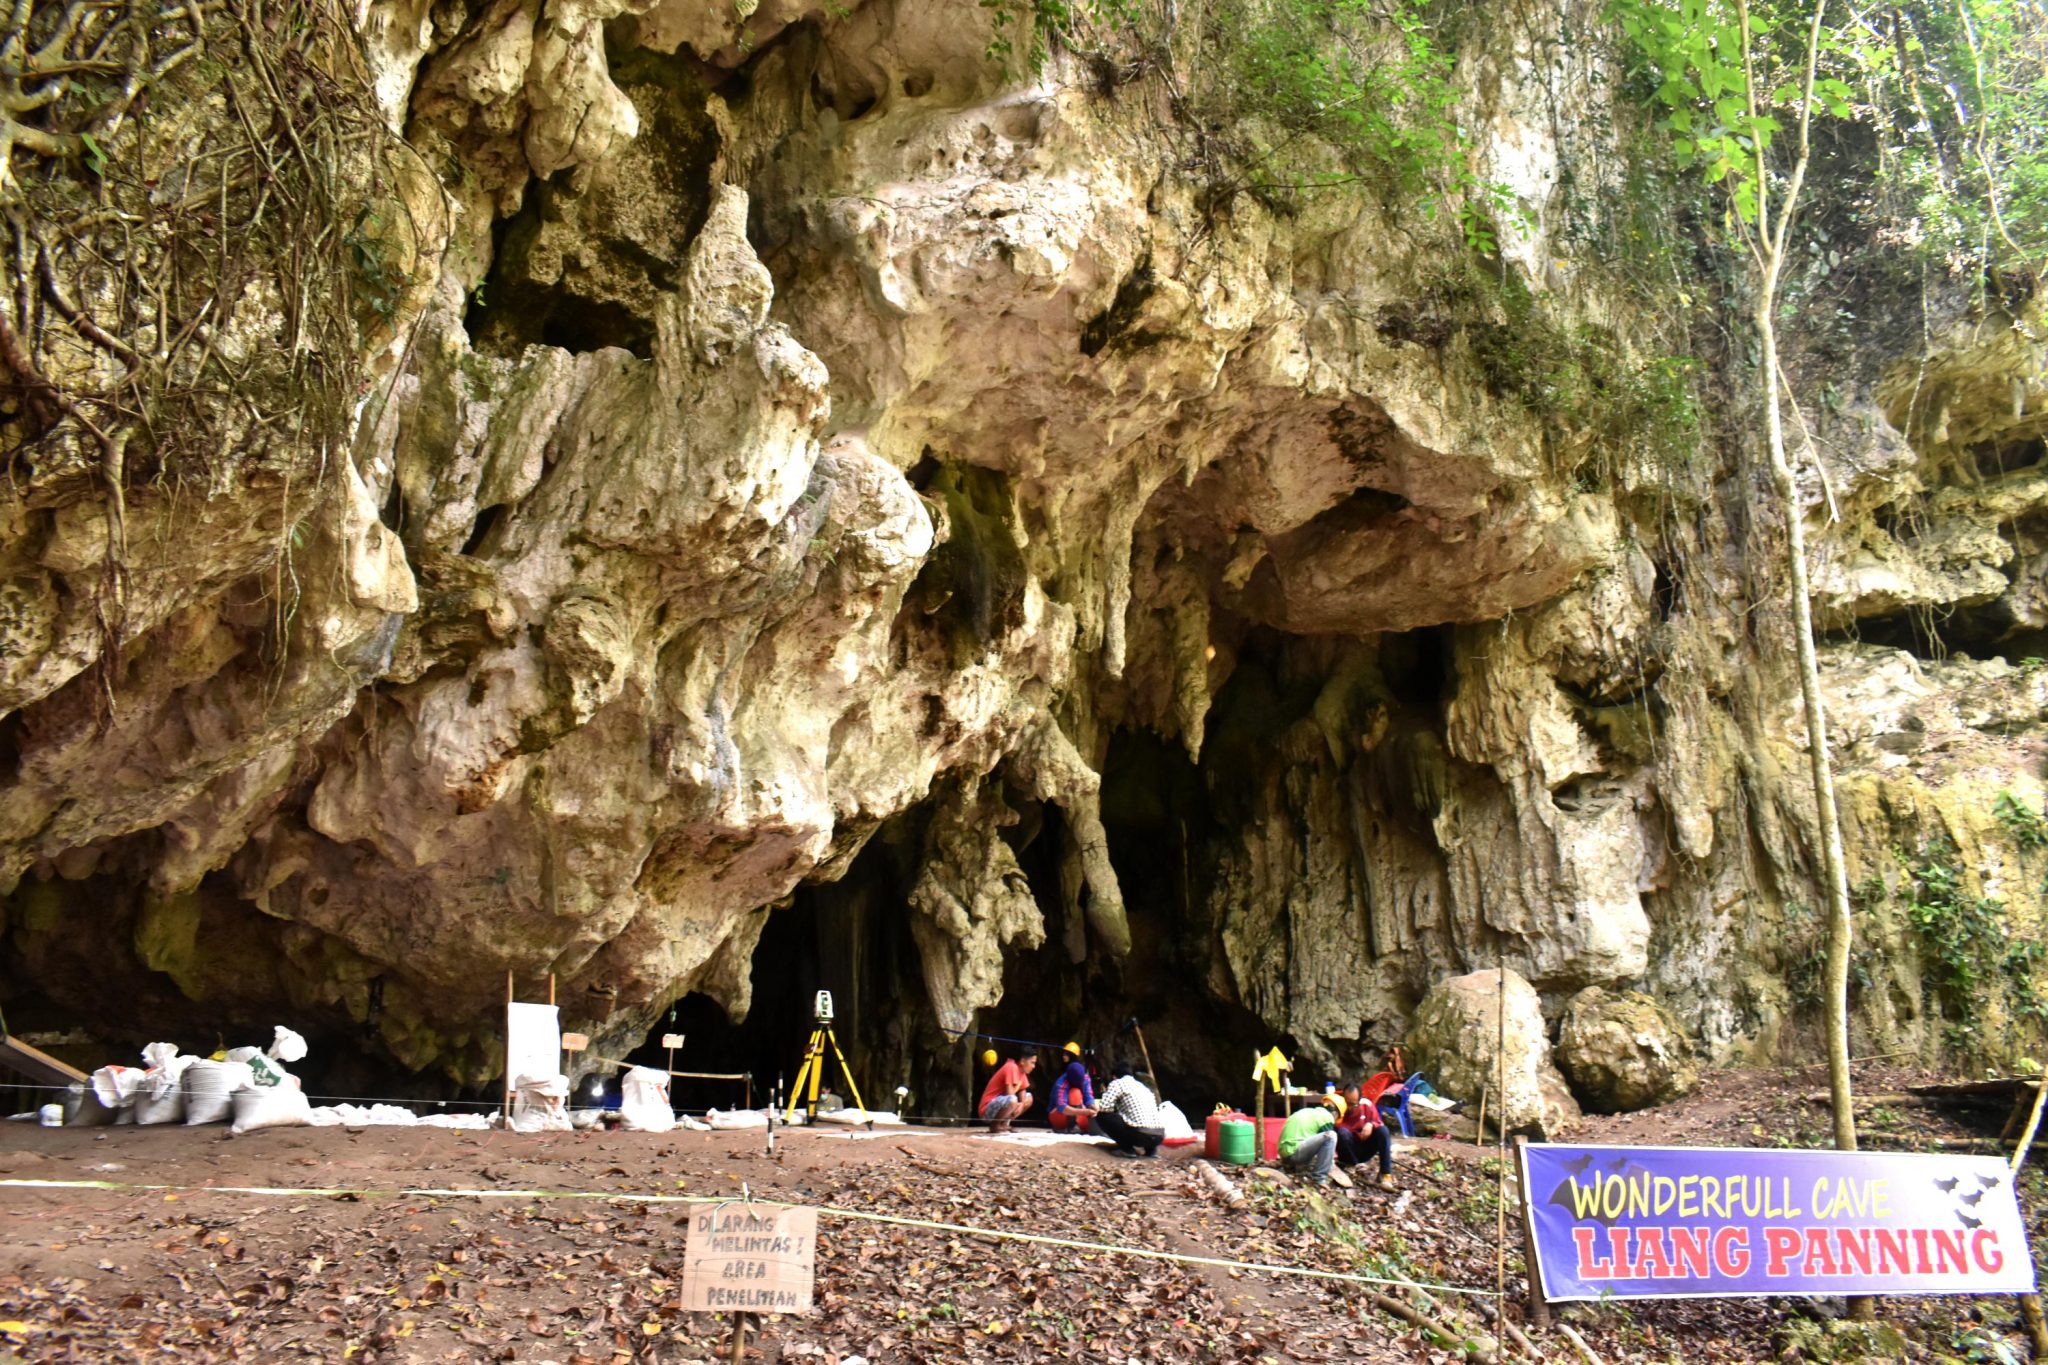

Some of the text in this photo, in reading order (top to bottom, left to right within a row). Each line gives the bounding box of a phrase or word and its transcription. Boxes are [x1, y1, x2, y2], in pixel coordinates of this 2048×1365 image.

[1569, 1170, 1892, 1219] WONDERFULL CAVE
[722, 1259, 766, 1278] AREA
[1573, 1226, 2004, 1280] LIANG PANNING
